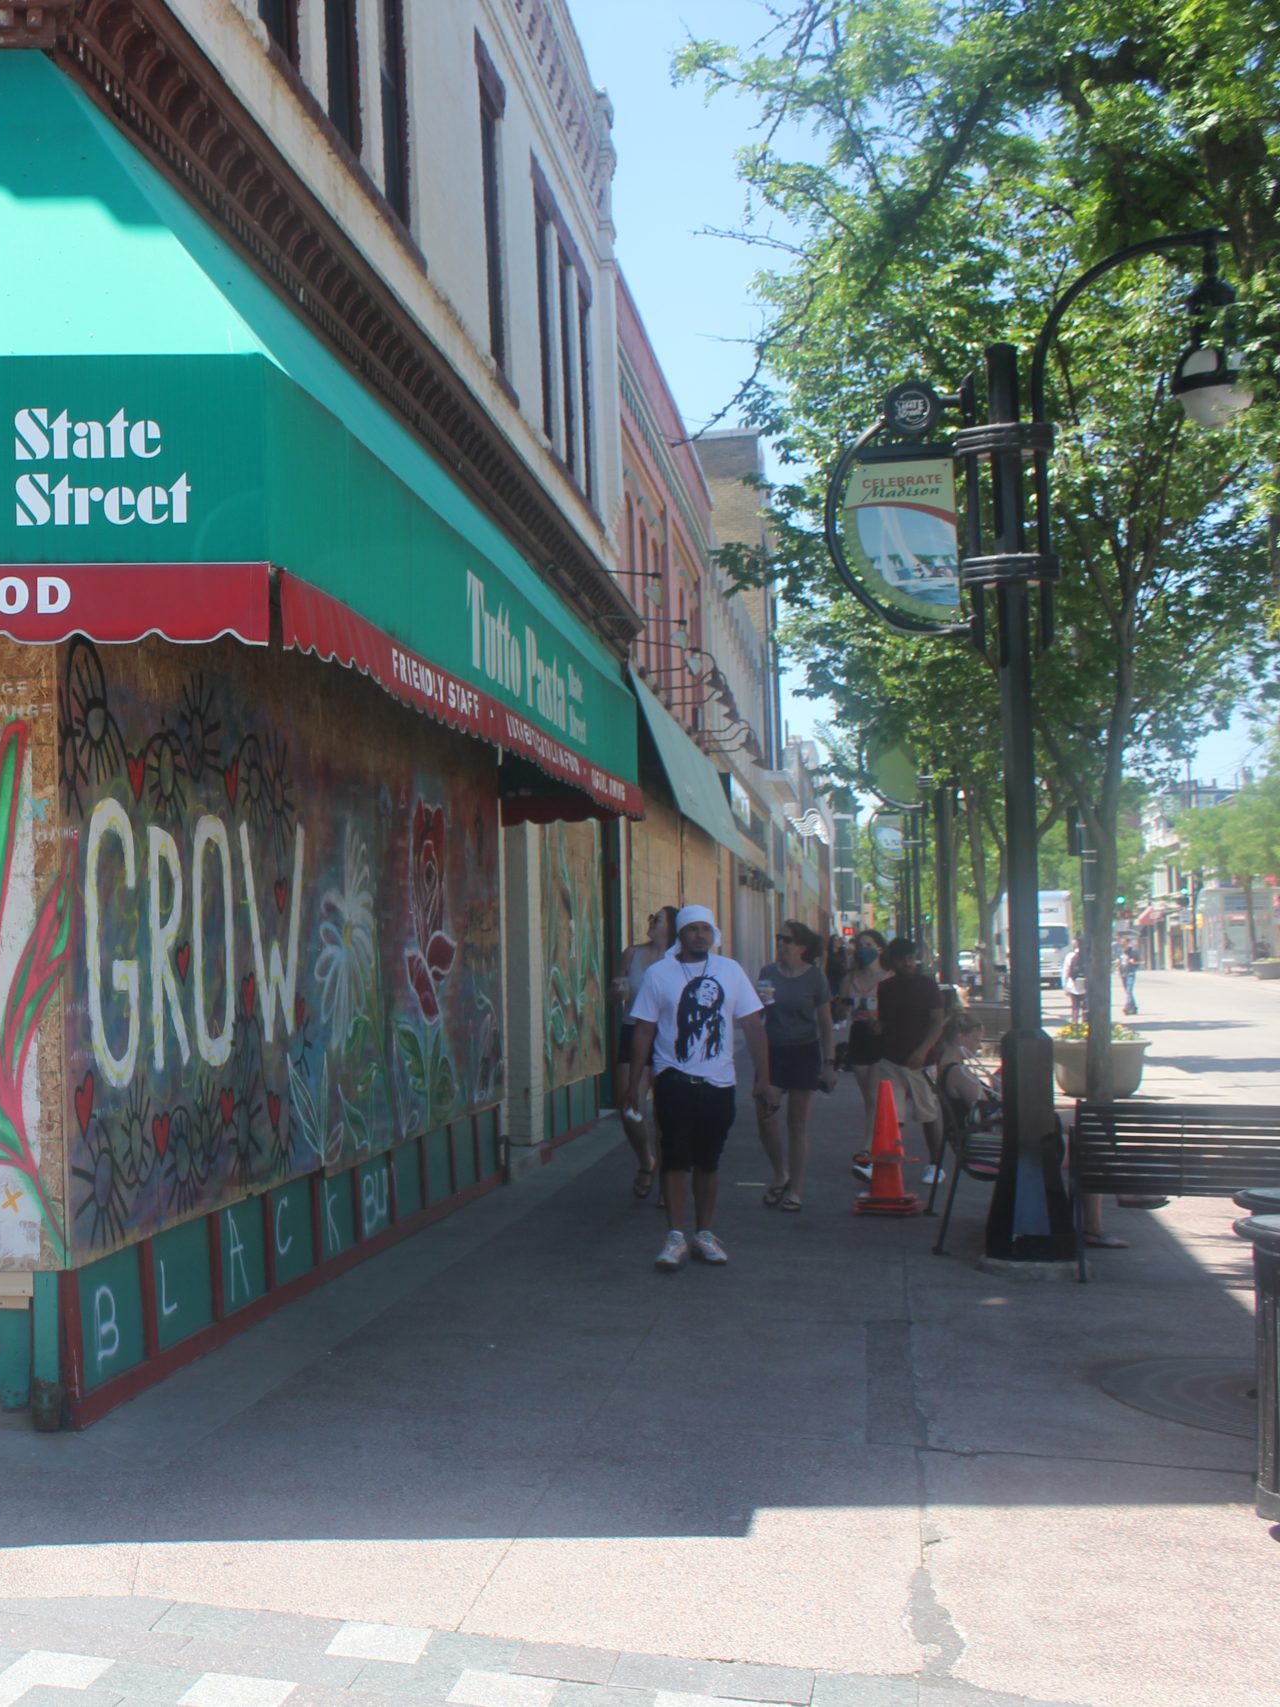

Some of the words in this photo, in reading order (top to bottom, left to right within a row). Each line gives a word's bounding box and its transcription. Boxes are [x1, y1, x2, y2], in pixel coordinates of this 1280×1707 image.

[14, 407, 161, 460] State
[15, 472, 191, 526] Street
[860, 485, 940, 503] Madison
[862, 474, 943, 489] CELEBRATE
[466, 569, 520, 698] Tutto
[525, 625, 566, 732] Pasta
[391, 647, 444, 703] FRIENDLY
[447, 681, 479, 719] STAFF
[84, 797, 305, 1089] GROW
